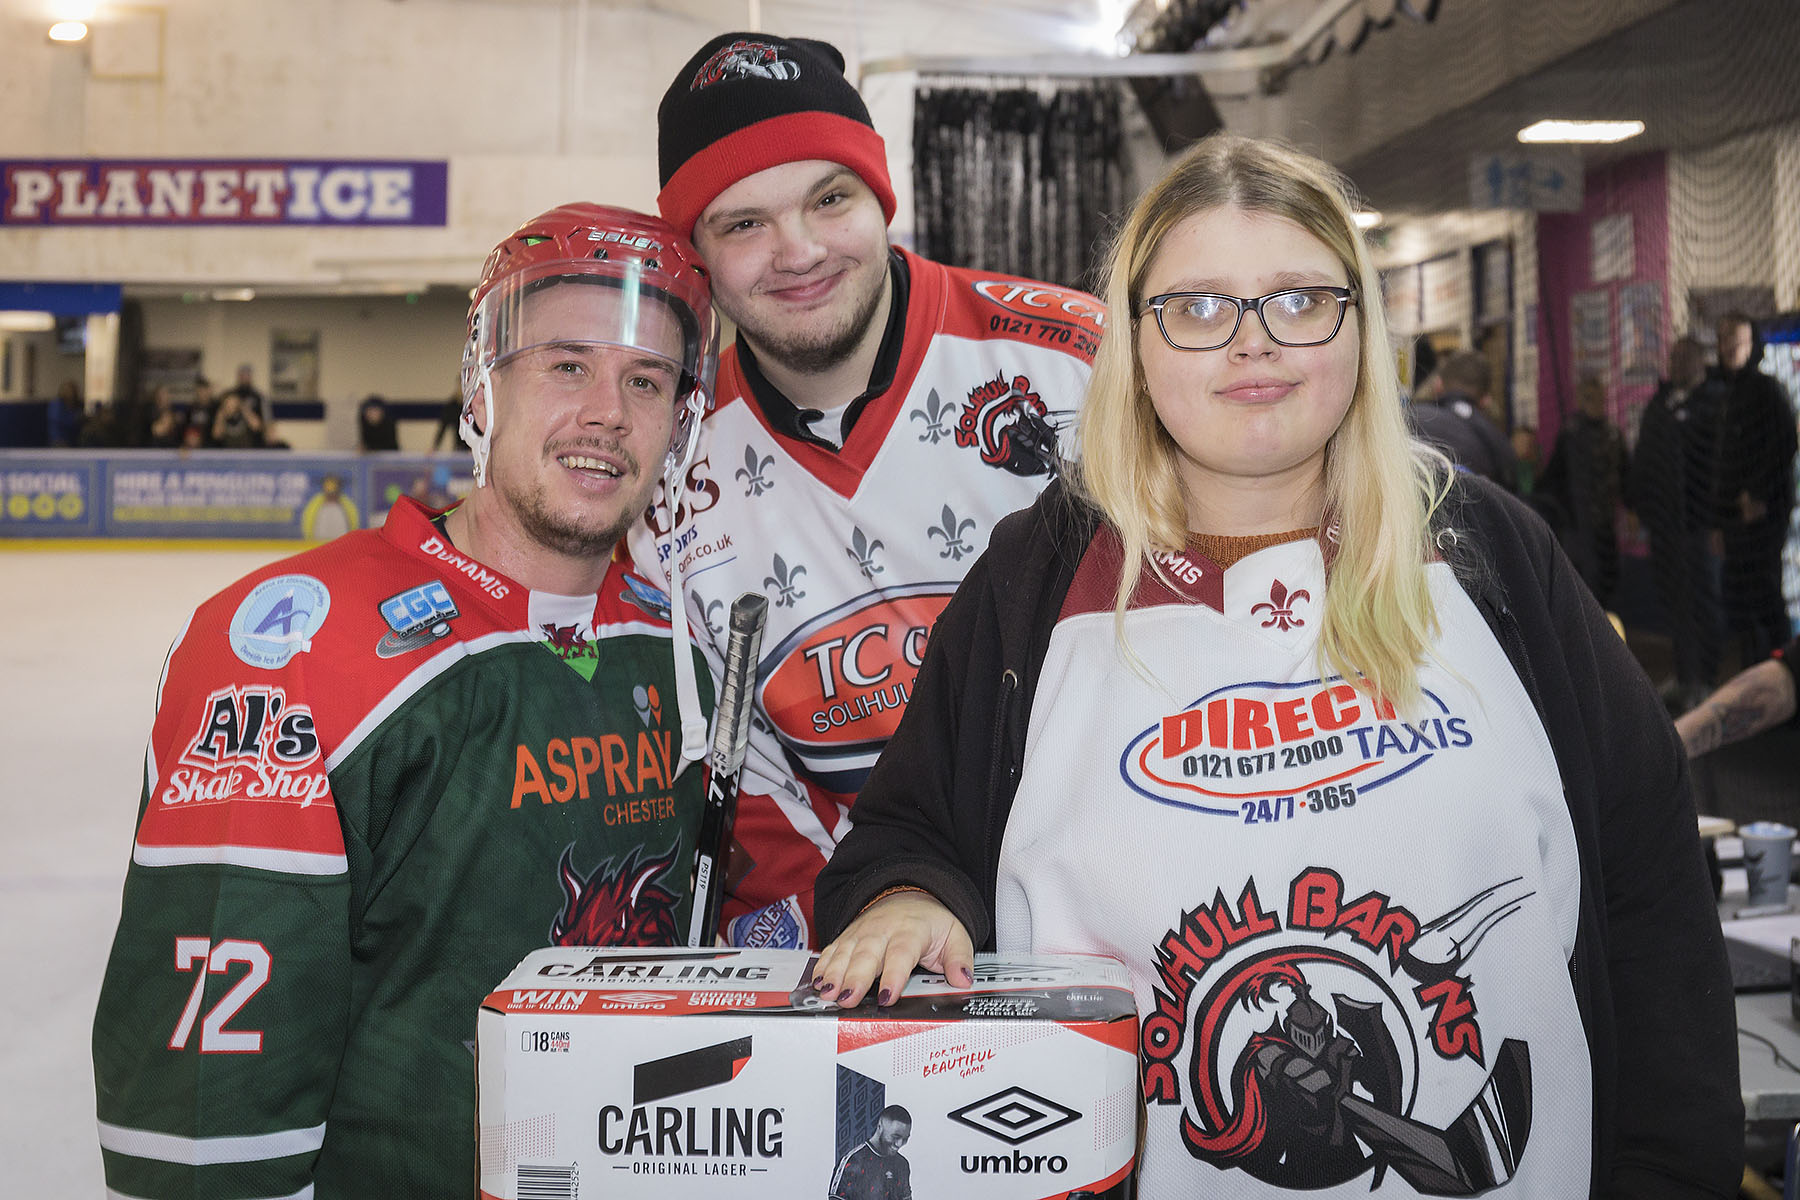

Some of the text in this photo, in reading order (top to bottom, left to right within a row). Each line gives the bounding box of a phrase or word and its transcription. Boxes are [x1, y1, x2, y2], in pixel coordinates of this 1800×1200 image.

[1002, 284, 1107, 328] TC CA
[990, 315, 1097, 357] 0121 770 20
[382, 583, 453, 631] CGC
[804, 624, 893, 702] TC
[184, 687, 321, 768] Al's
[812, 680, 918, 733] SOLIHUL
[1182, 735, 1344, 779] 0121 677 2000
[1346, 717, 1474, 760] TAXIS
[162, 765, 330, 809] Skate Shop
[510, 730, 673, 809] ASPRAY
[603, 796, 676, 826] CHESTER
[537, 964, 772, 980] CARLING
[921, 976, 1055, 986] ubro
[1140, 874, 1283, 1106] SOLIHULL
[167, 936, 273, 1055] 72
[512, 990, 589, 1005] WIN
[601, 1002, 666, 1010] umbro
[687, 997, 757, 1007] SHIRTS
[532, 1031, 570, 1052] 18 CANS
[929, 1044, 967, 1061] FOR THE
[923, 1048, 996, 1078] BEAUTIFUL
[959, 1064, 985, 1079] GAME
[598, 1105, 783, 1158] CARLING
[633, 1162, 747, 1176] ORIGINAL LAGER
[961, 1150, 1068, 1174] umbro
